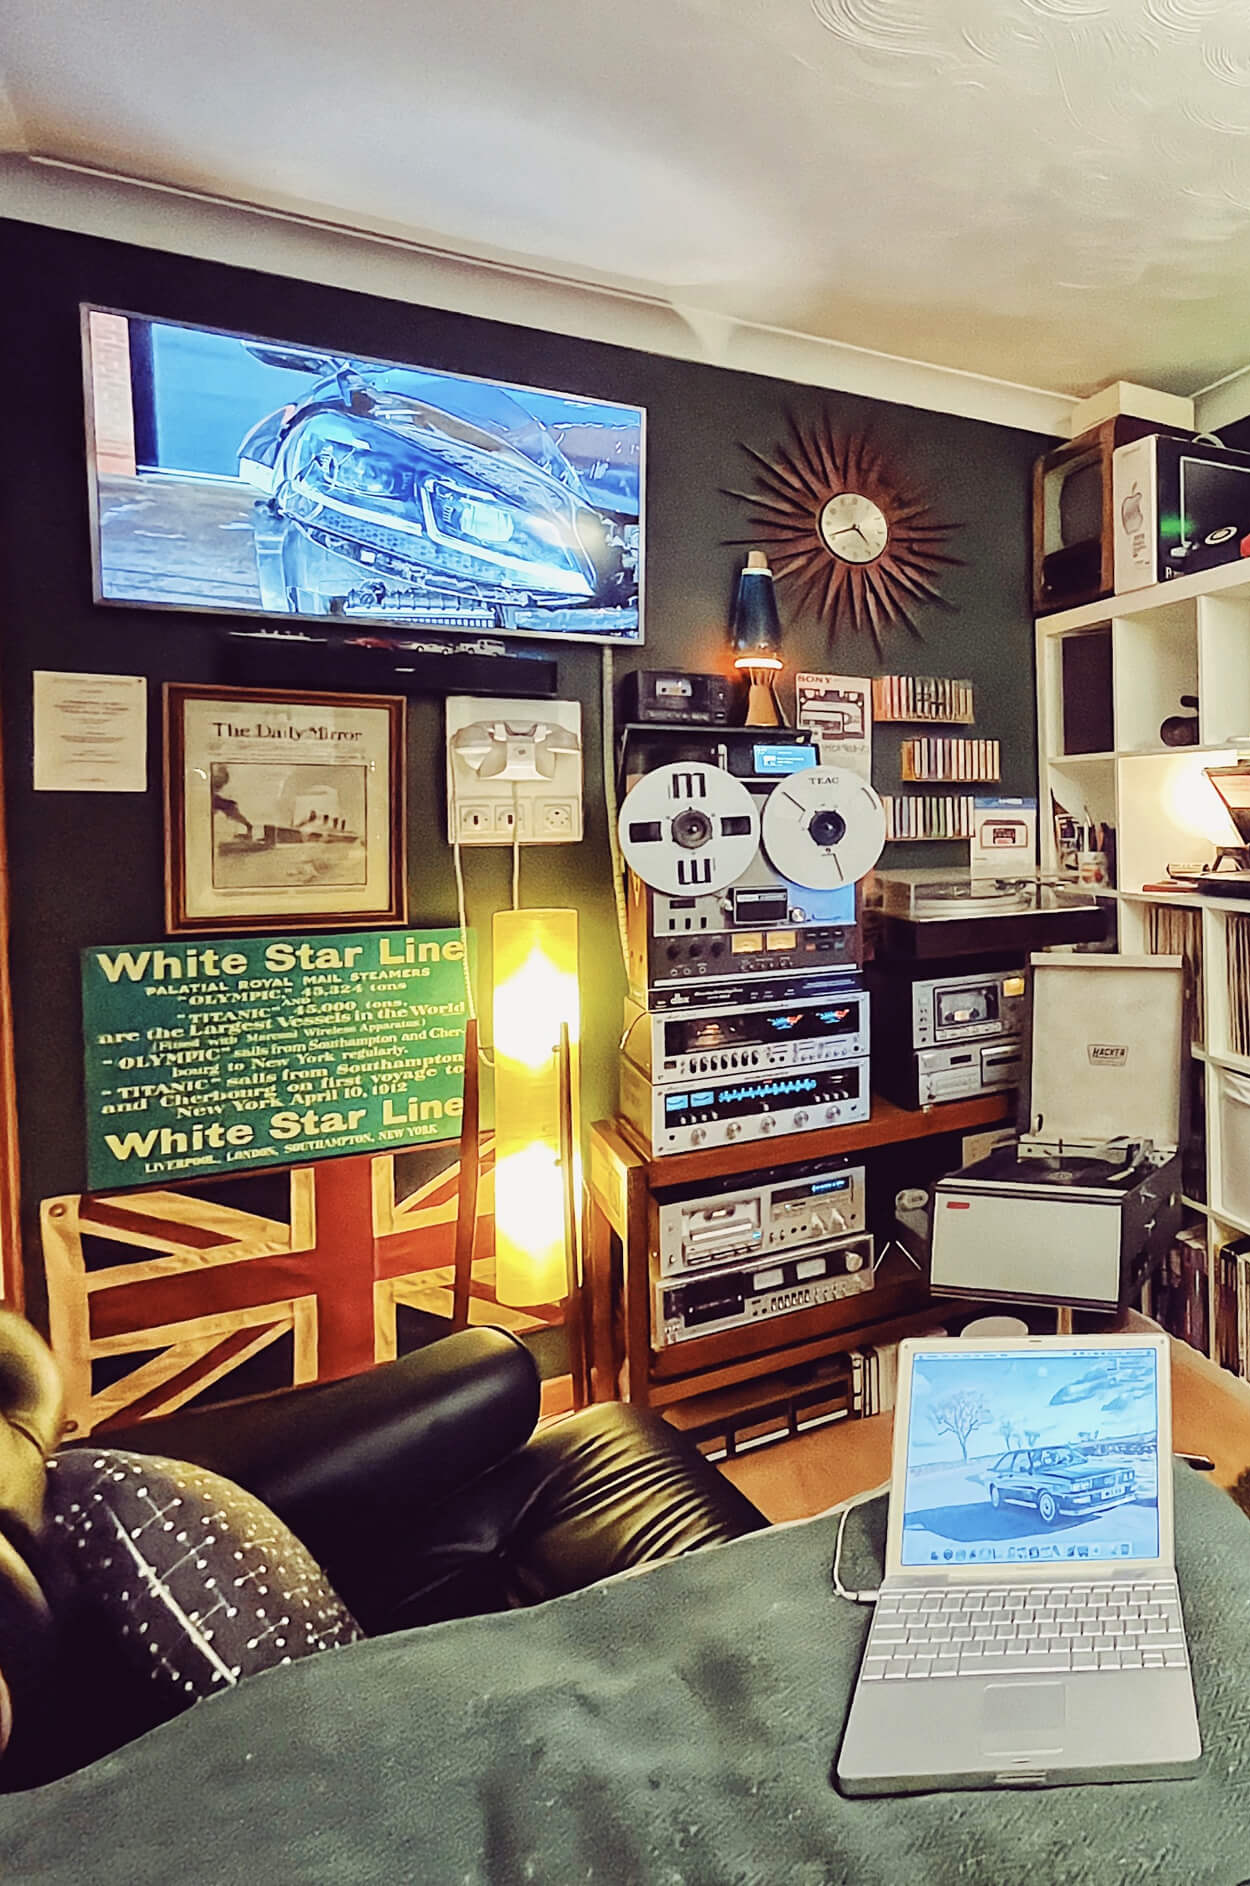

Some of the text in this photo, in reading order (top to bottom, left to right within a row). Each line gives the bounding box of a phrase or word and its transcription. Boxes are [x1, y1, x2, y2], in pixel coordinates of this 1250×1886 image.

[798, 675, 832, 684] SONY
[212, 722, 363, 742] The Daily Mirror
[808, 777, 839, 785] TEAC
[96, 936, 465, 983] White Star Line
[144, 967, 431, 996] PALATIAL ROYAL MAIL STEAMERS
[370, 982, 408, 992] tons
[98, 1001, 465, 1044] are the Largest Vessels in the World
[233, 1045, 270, 1057] sails
[271, 1043, 307, 1057] from
[308, 1035, 397, 1051] Southampton
[401, 1030, 427, 1042] and
[429, 1026, 464, 1038] Cher-
[172, 1063, 221, 1078] bourg
[227, 1062, 246, 1072] to
[251, 1057, 290, 1071] New
[296, 1052, 336, 1064] York
[226, 1072, 277, 1087] sails
[282, 1067, 329, 1081] from
[336, 1053, 464, 1075] Southampton
[102, 1064, 464, 1115] and Cherbourg on first voyage to
[176, 1105, 225, 1119] New
[231, 1097, 285, 1112] York
[290, 1089, 338, 1107] April
[372, 1082, 408, 1095] 1912
[104, 1096, 464, 1161] White Star Line
[378, 1128, 405, 1142] NEW
[406, 1124, 439, 1137] YORK
